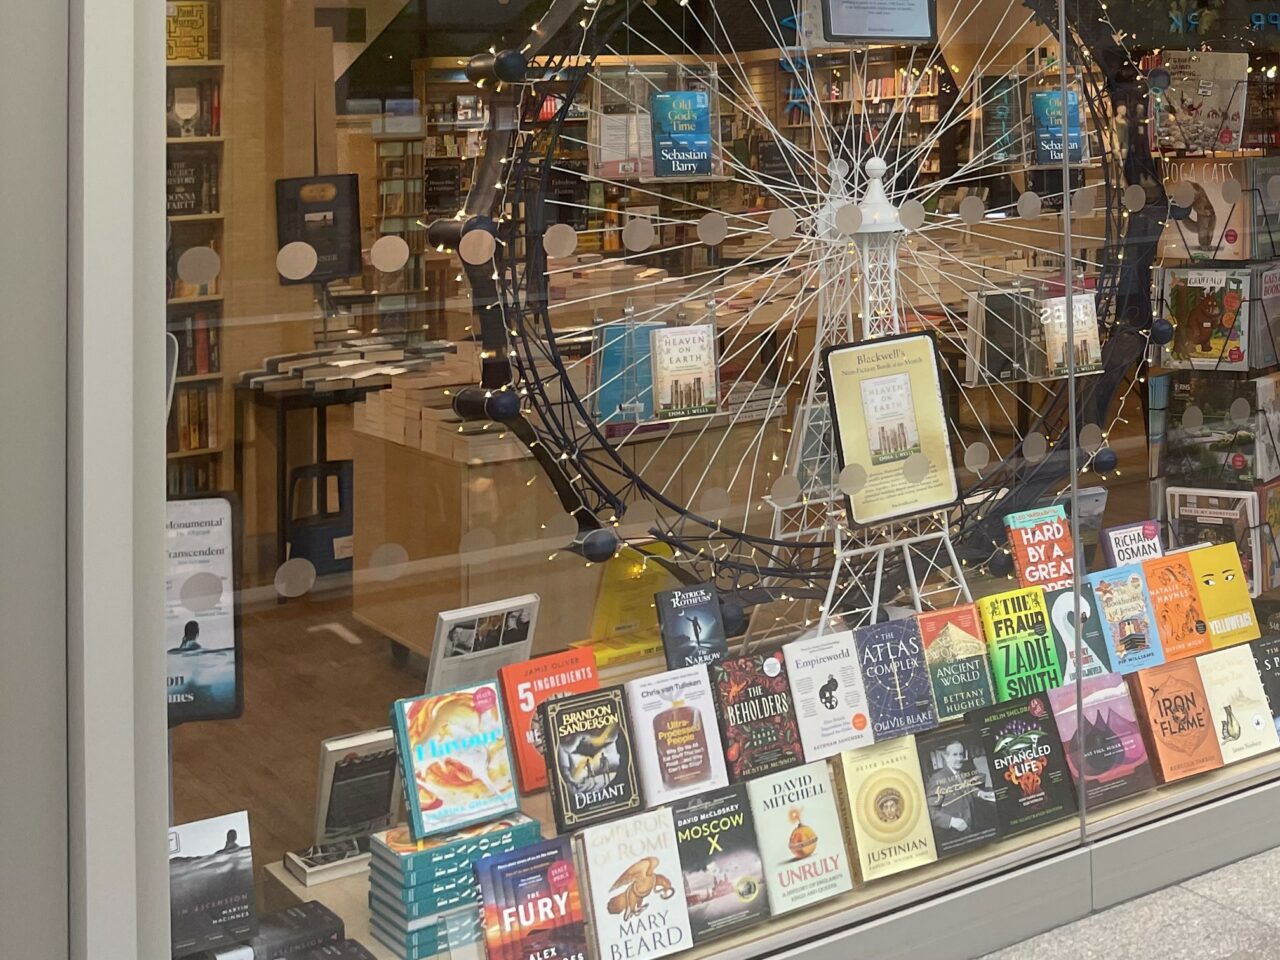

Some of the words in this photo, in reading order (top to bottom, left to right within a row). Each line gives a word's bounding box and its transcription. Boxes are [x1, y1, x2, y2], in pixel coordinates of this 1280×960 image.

[672, 99, 694, 110] Old
[668, 109, 699, 122] God's
[671, 120, 697, 132] Time
[661, 149, 708, 162] Sebastian
[672, 160, 699, 174] Barry
[1165, 162, 1196, 182] YOGA
[1202, 162, 1233, 183] CATS
[665, 336, 706, 347] HEAVEN
[679, 346, 691, 354] ON
[669, 353, 703, 365] EARTH
[856, 349, 906, 365] Blackwell's
[668, 410, 686, 418] EMMA
[1020, 523, 1064, 545] HARD
[1027, 547, 1046, 563] BY
[1053, 543, 1064, 558] A
[1117, 542, 1158, 562] OSMAN
[1025, 559, 1075, 583] GREAT
[672, 589, 705, 600] PATRICK
[1150, 585, 1180, 596] NATALIE
[1157, 590, 1188, 603] HAYNES
[670, 593, 712, 608] ROTHFUSS
[1000, 592, 1034, 615] THE
[993, 610, 1046, 638] FRAUD
[1209, 611, 1253, 636] YELLOWFACE
[881, 632, 895, 640] THE
[685, 651, 721, 667] NARROW
[795, 648, 850, 670] Empireworld
[863, 636, 919, 665] ATLAS
[998, 635, 1055, 677] ZADIE
[1129, 652, 1155, 663] WILLIAMS
[1267, 646, 1279, 655] TIM
[524, 665, 548, 676] JAMIE
[551, 657, 580, 670] OLIVER
[866, 657, 919, 678] COMPLEX
[936, 659, 981, 678] ANCIENT
[940, 670, 981, 687] WORLD
[1007, 669, 1060, 700] SMITH
[517, 681, 536, 712] 5
[533, 666, 593, 692] INGREDIENTS
[641, 688, 658, 698] Chris
[675, 679, 702, 691] Tulleken
[747, 685, 763, 698] THE
[943, 687, 985, 704] BETTANY
[727, 693, 789, 726] BEHOLDERS
[946, 698, 986, 714] HUGHES
[1157, 691, 1196, 719] IRON
[562, 704, 612, 726] BRANDON
[874, 716, 905, 733] OLIVIE
[906, 709, 933, 725] BLAKE
[984, 712, 1006, 723] MERLIN
[558, 713, 619, 737] SANDERSON
[666, 719, 690, 731] Ultra-
[1160, 713, 1205, 738] FLAME
[667, 733, 695, 747] People
[993, 744, 1051, 770] ENTANGLED
[742, 762, 768, 776] HESTER
[1014, 760, 1039, 777] LIFE
[772, 774, 812, 795] DAVID
[575, 783, 625, 809] DEFIANT
[763, 783, 827, 813] MITCHELL
[592, 812, 670, 848] EMPEROR
[677, 814, 699, 827] DAVID
[678, 813, 744, 843] MOSCOW
[594, 851, 613, 867] OF
[617, 831, 670, 858] ROME
[707, 835, 723, 855] X
[867, 837, 928, 866] JUSTINIAN
[778, 854, 840, 888] UNRULY
[527, 891, 540, 899] THE
[502, 890, 570, 932] FURY
[619, 909, 669, 939] MARY
[610, 925, 684, 960] BEARD
[529, 947, 557, 960] ALEX
